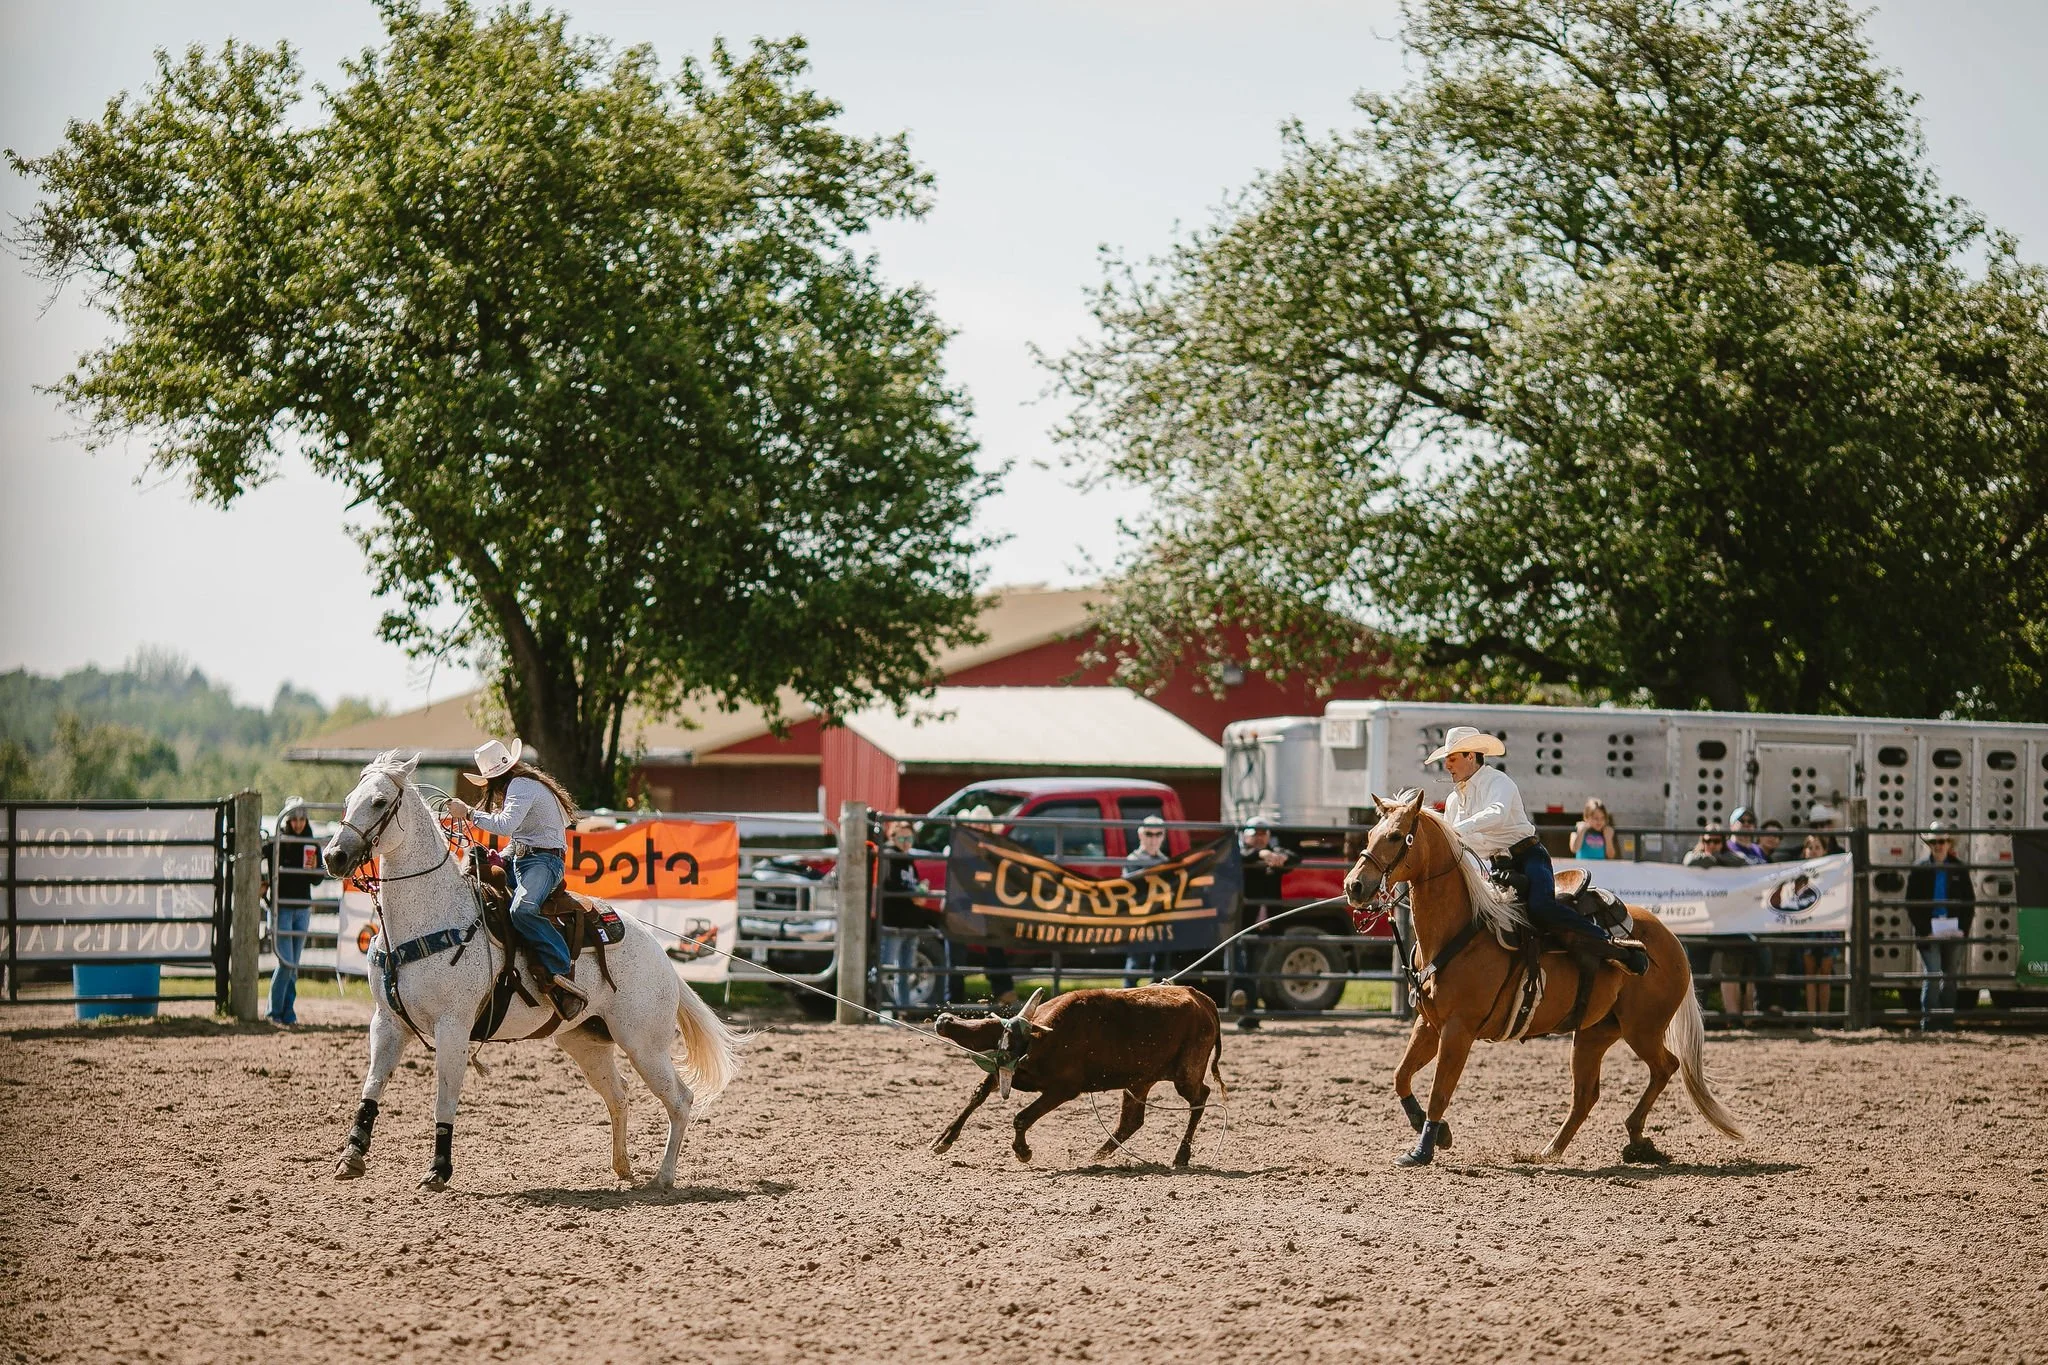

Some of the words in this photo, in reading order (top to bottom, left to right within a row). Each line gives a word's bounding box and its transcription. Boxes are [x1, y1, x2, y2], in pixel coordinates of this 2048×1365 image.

[489, 833, 699, 885] bota
[995, 857, 1203, 916] CORRAL
[1015, 921, 1123, 943] HANDCRAFTED
[1129, 924, 1174, 942] BOOTS
